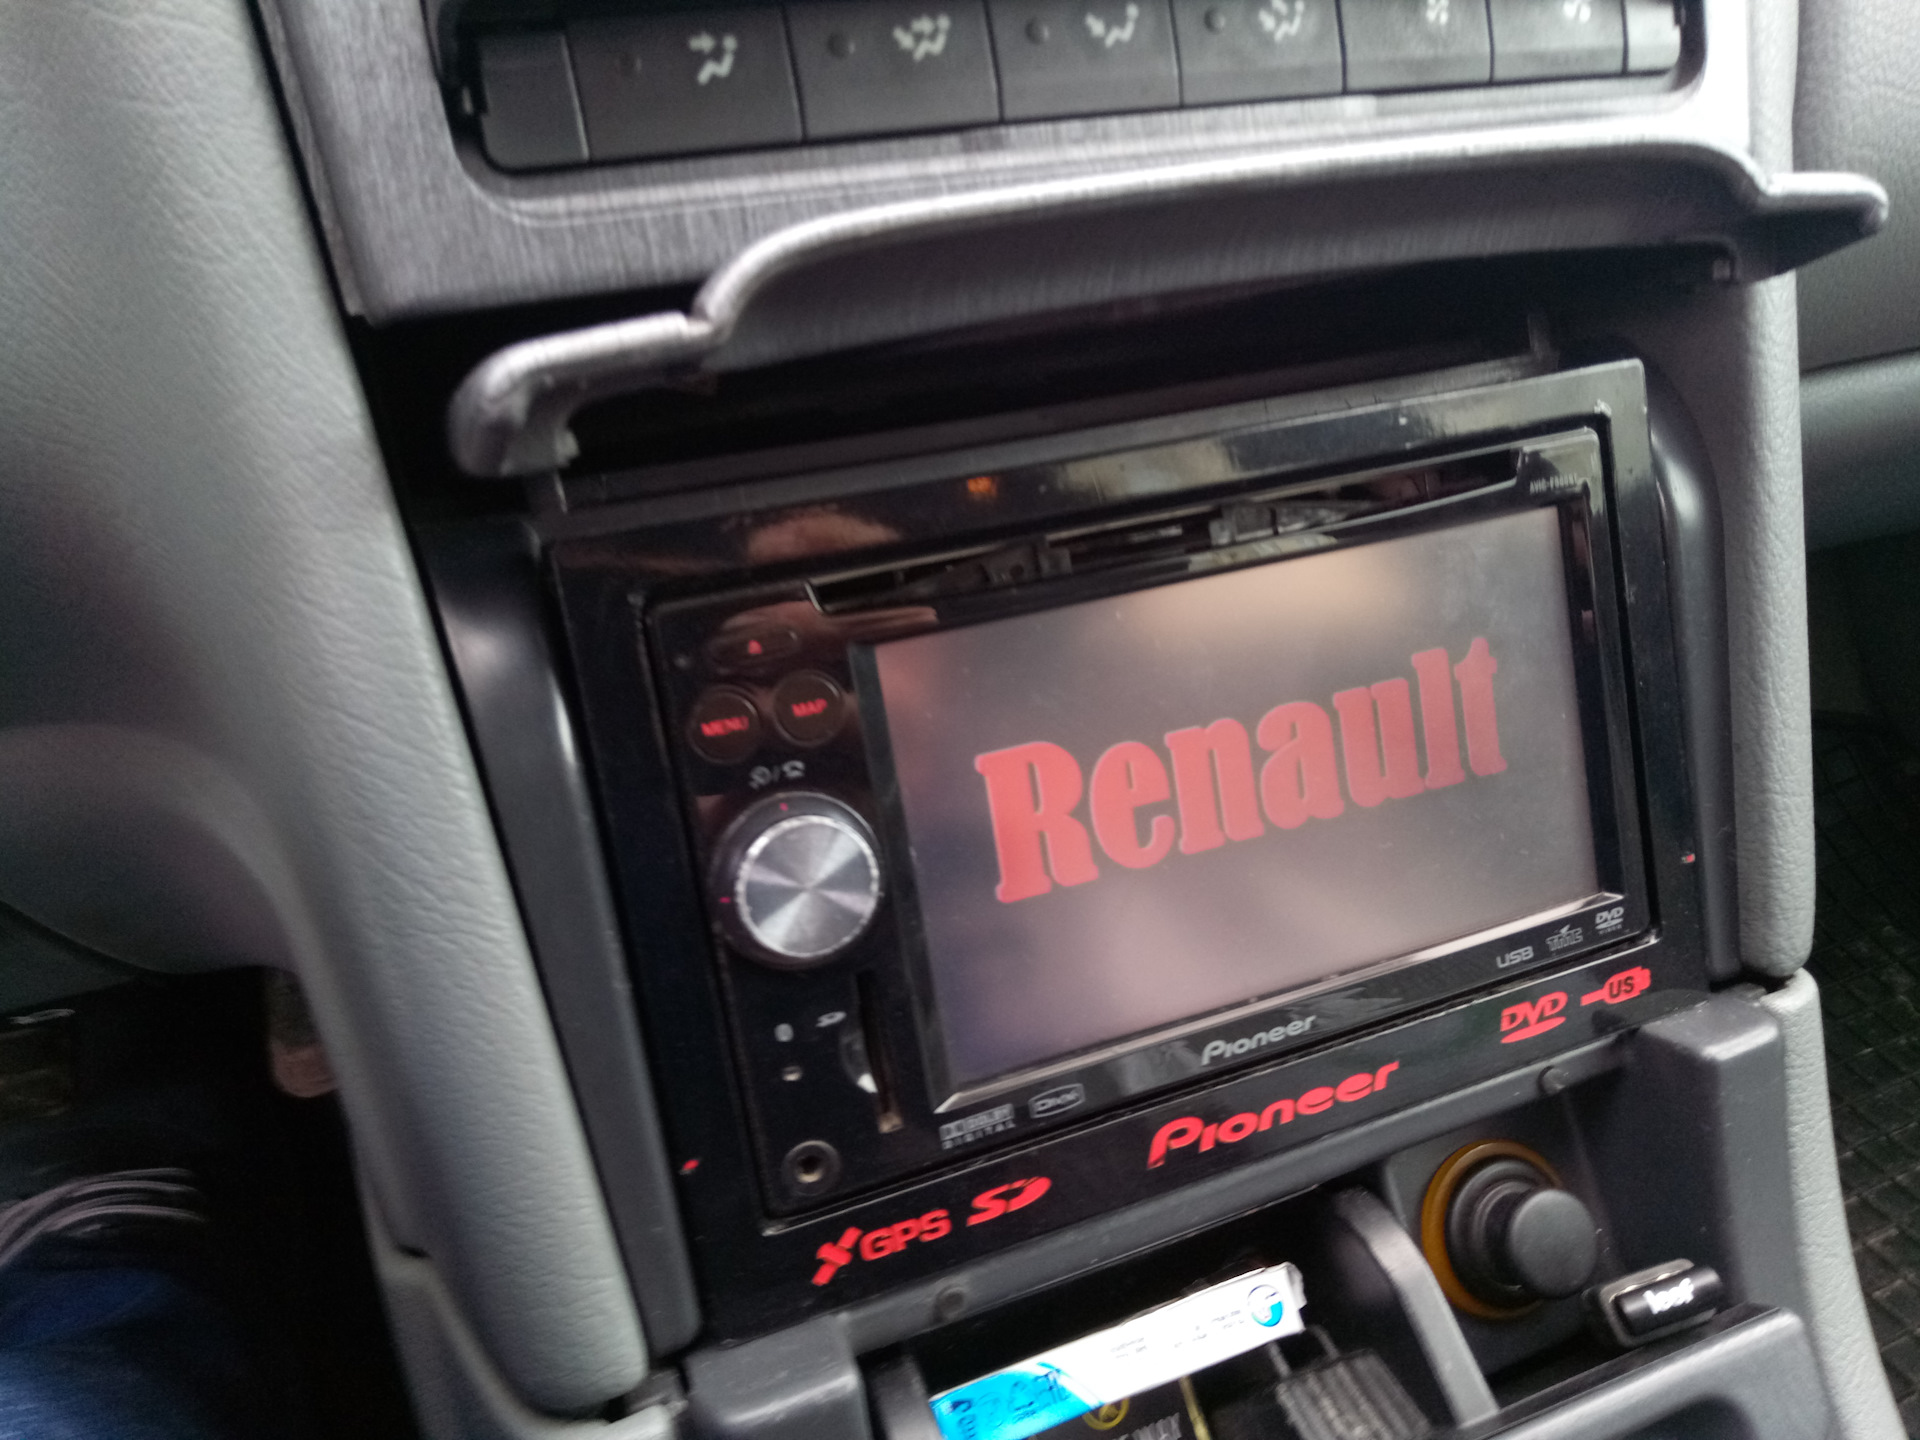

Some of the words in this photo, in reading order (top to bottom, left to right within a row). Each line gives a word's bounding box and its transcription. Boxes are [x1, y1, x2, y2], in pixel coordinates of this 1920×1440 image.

[701, 715, 749, 737] MENU
[792, 698, 828, 718] MAP
[974, 636, 1507, 903] Renault
[1496, 945, 1534, 969] USB
[1500, 990, 1569, 1032] DVD
[1201, 1015, 1317, 1065] Pioneer
[1147, 1060, 1399, 1170] Pioneer
[965, 1176, 1052, 1226] SD
[859, 1208, 953, 1262] GPS
